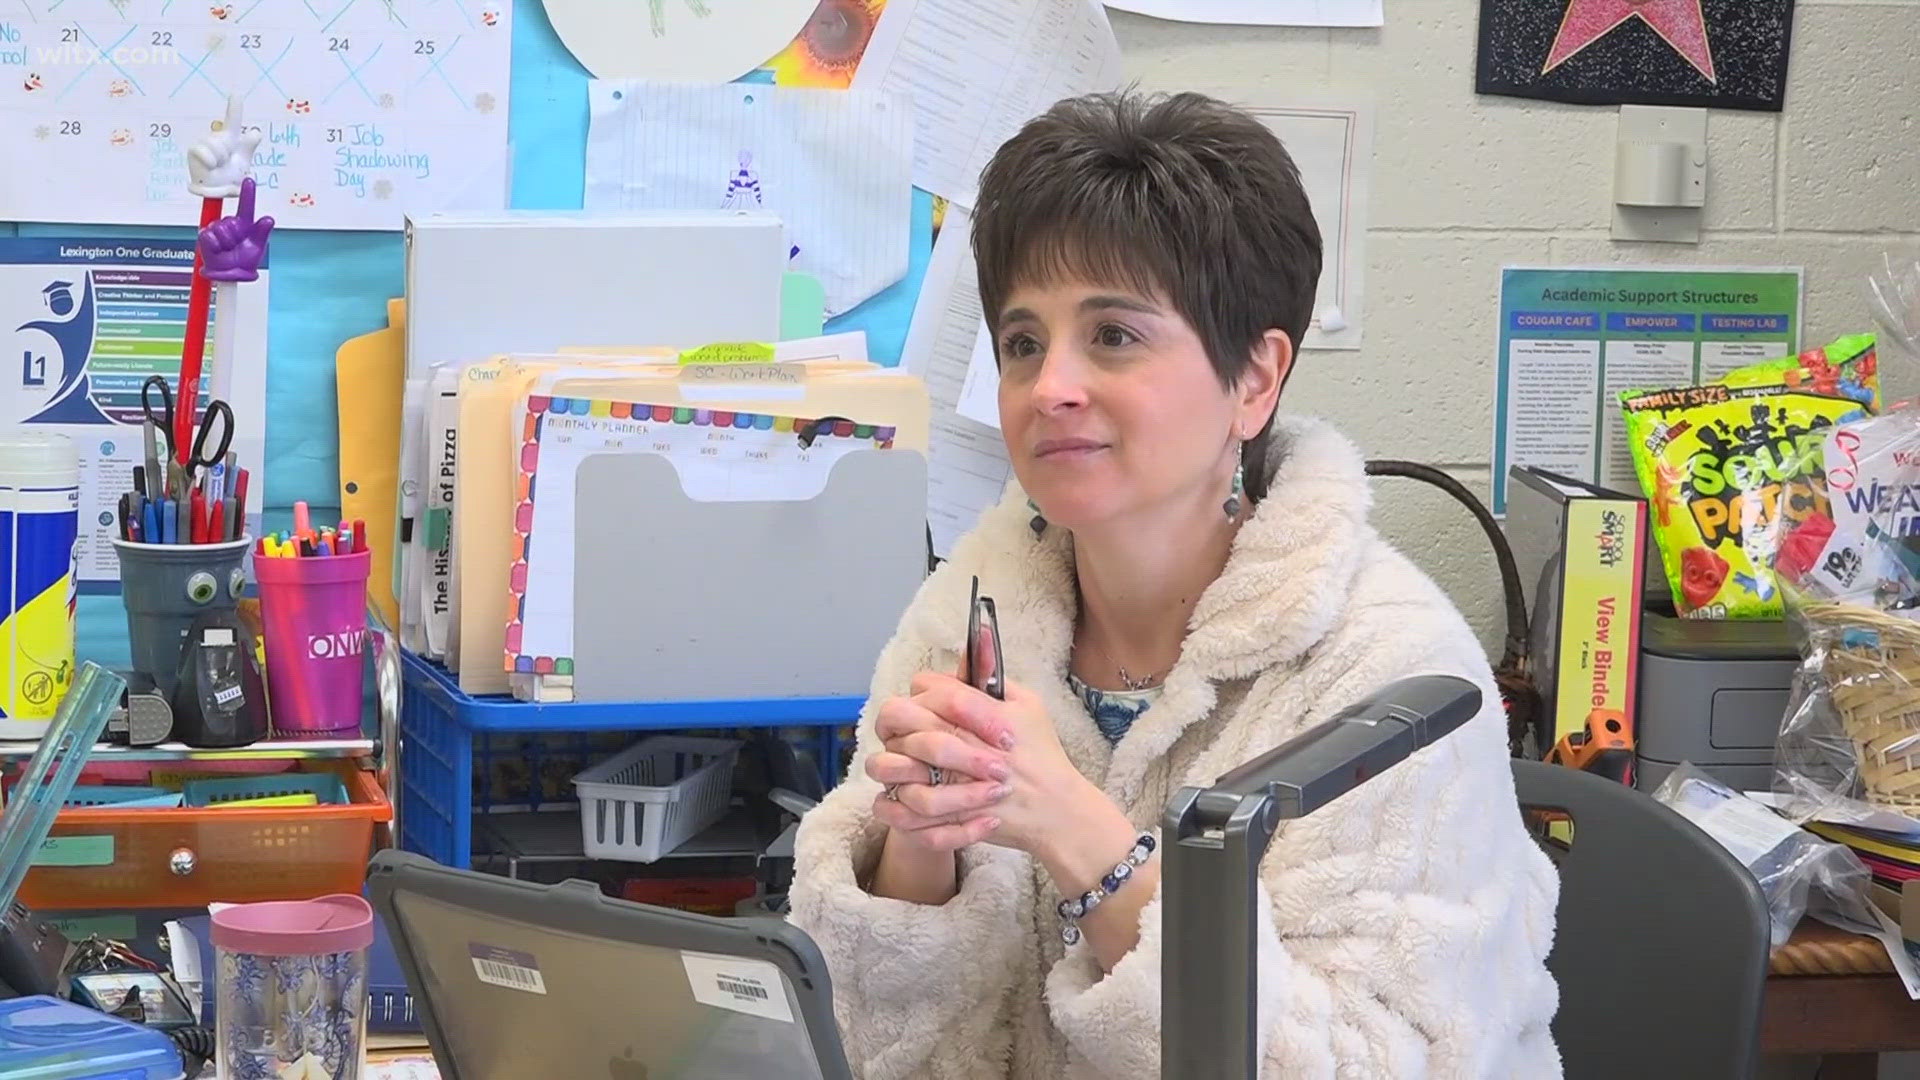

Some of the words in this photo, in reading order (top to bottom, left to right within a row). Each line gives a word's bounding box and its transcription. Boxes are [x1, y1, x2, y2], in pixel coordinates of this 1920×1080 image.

[61, 28, 79, 43] 21
[151, 31, 173, 47] 22
[240, 34, 262, 49] 23
[328, 37, 350, 51] 24
[414, 39, 436, 55] 25
[60, 120, 81, 135] 28
[150, 123, 171, 138] 29
[326, 128, 343, 143] 31
[347, 122, 384, 147] Job
[250, 147, 288, 168] ade
[334, 146, 430, 180] Shadowing
[334, 168, 366, 198] Day
[61, 246, 113, 260] Lexington
[116, 247, 140, 258] One
[143, 248, 195, 260] Graduate
[1542, 288, 1616, 302] Academic
[1618, 289, 1678, 306] Support
[1682, 290, 1759, 304] Structures
[1517, 315, 1562, 326] COUGAR
[1564, 316, 1593, 326] CAFE
[1625, 317, 1678, 327] EMPOWER
[1712, 318, 1754, 329] TESTING
[1757, 319, 1777, 329] LAB
[441, 428, 456, 477] Pizza
[1690, 433, 1829, 496] SOUR
[440, 481, 454, 503] of
[434, 581, 448, 614] The
[1596, 597, 1616, 644] View
